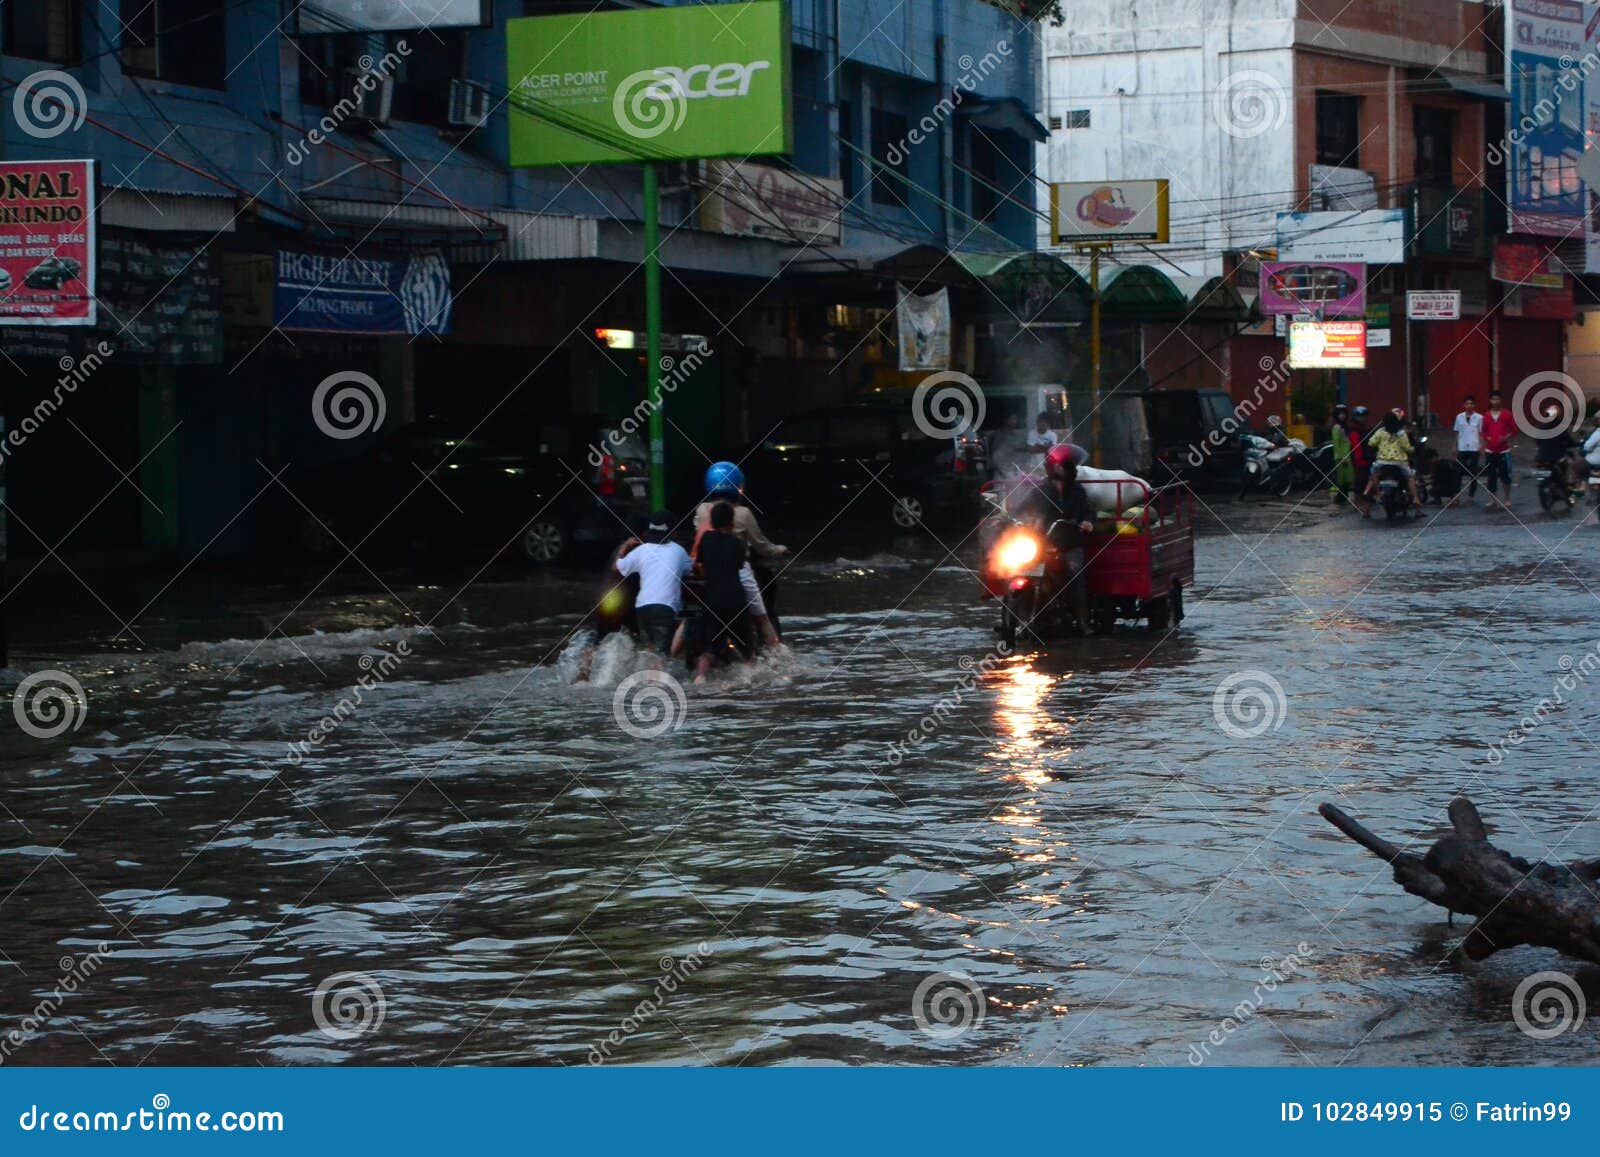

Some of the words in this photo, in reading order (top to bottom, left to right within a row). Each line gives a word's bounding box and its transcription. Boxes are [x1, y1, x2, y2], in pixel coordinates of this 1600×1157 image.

[520, 74, 560, 89] ACER
[564, 70, 609, 87] POINT
[645, 60, 770, 100] acer
